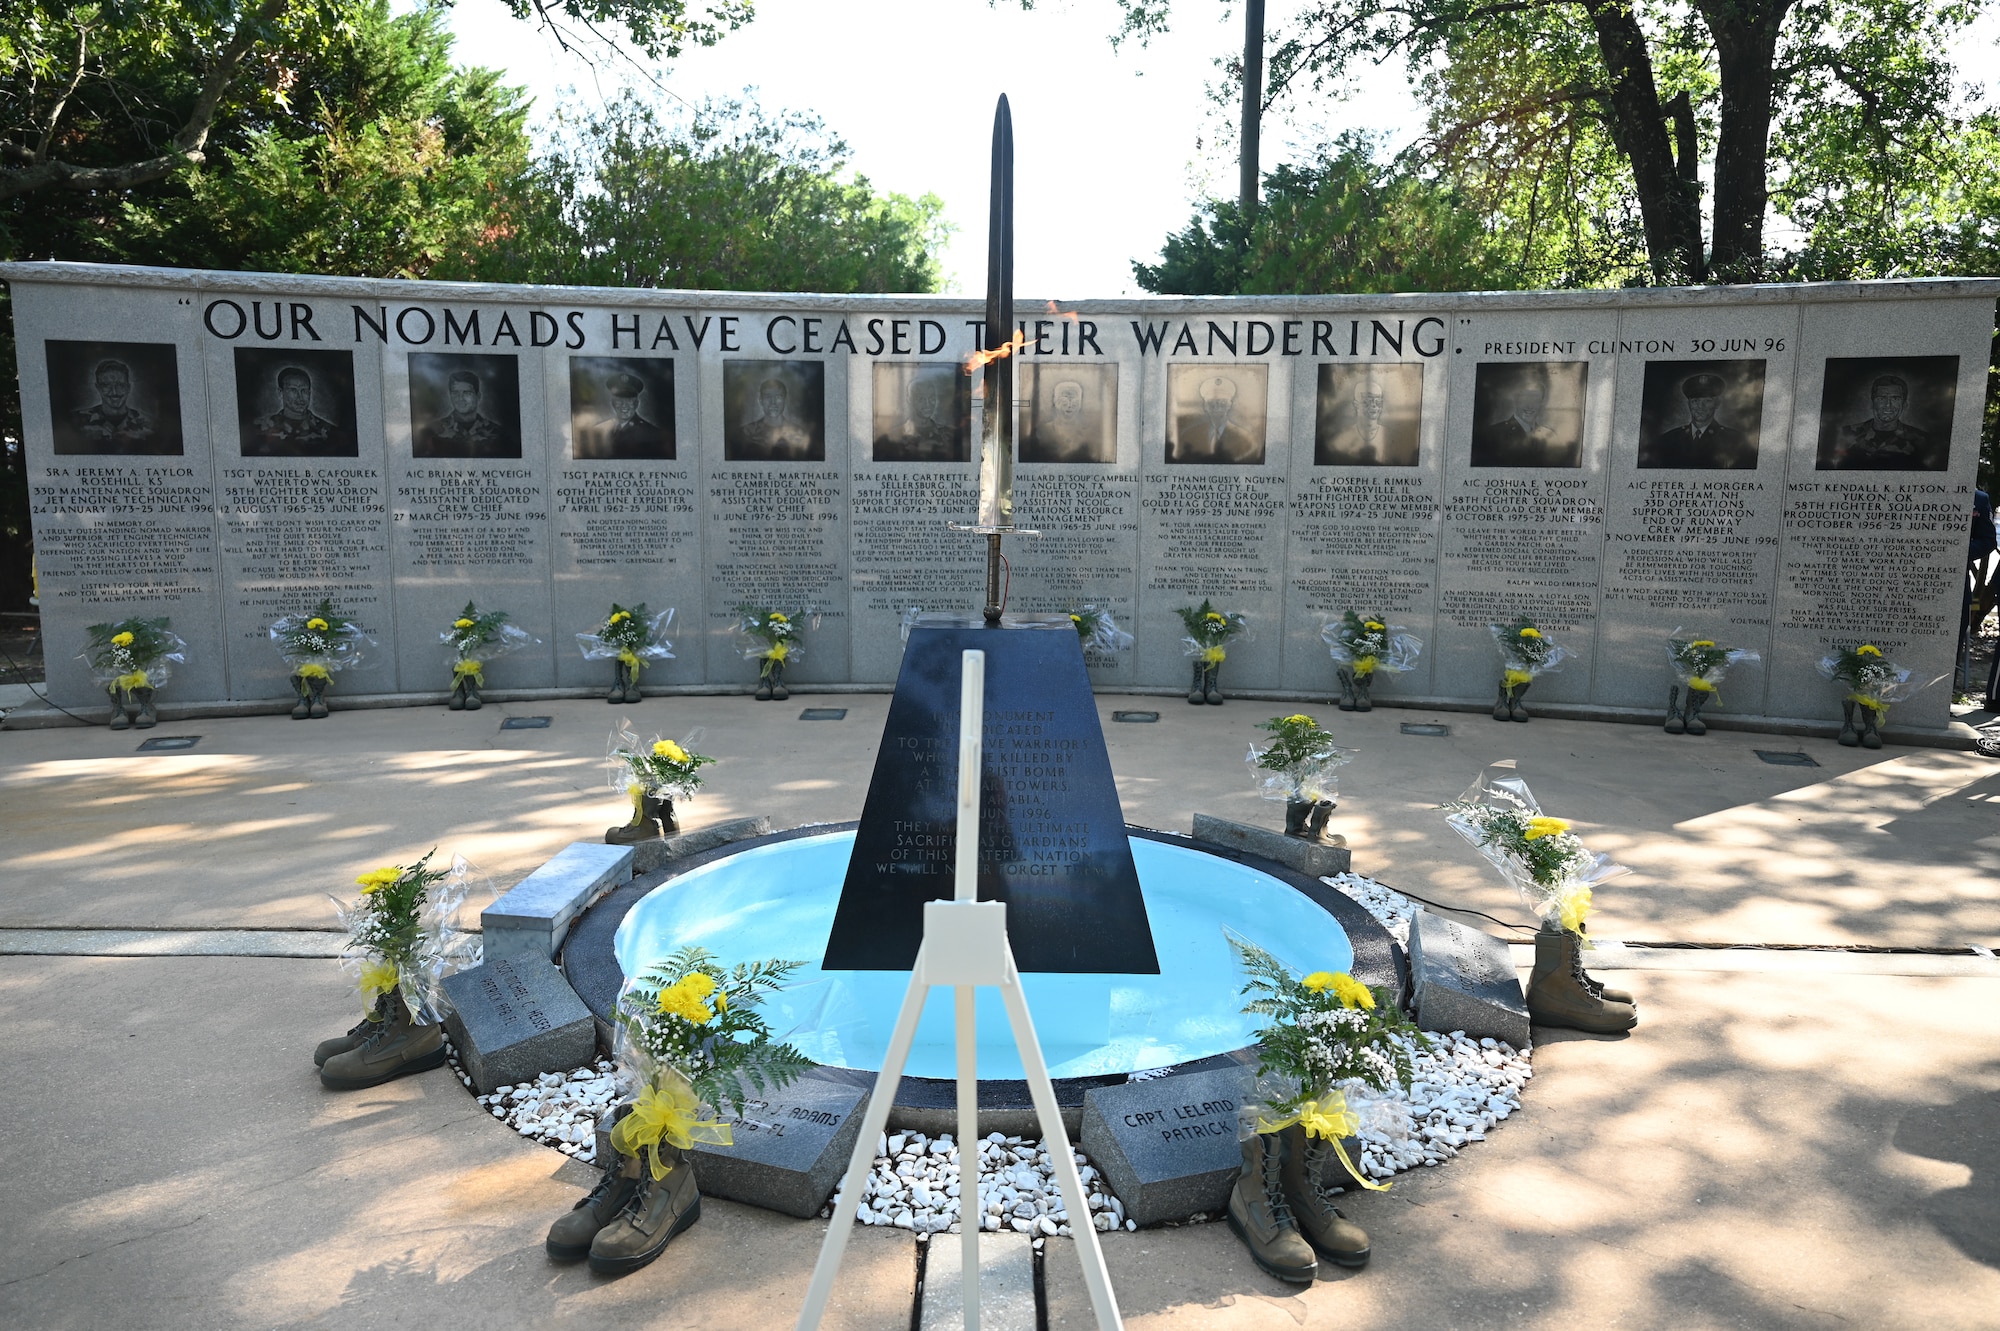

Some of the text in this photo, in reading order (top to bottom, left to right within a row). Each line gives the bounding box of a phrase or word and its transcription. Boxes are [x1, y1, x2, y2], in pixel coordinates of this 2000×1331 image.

[352, 304, 586, 350] NOMADS
[611, 314, 741, 352] HAVE
[766, 316, 947, 356] CEASED
[1484, 338, 1786, 355] PRESIDENT CLINTON 30 JUN 96
[46, 467, 194, 477] SRA JEREMY A. TAYLOR
[223, 469, 378, 478] TSGT DANIEL B. CAFOUREK
[428, 470, 463, 478] BRIAN
[467, 470, 478, 478] W.
[482, 470, 532, 478] MCVEIGH
[562, 471, 587, 480] TSGT
[592, 471, 634, 479] PATRICK
[649, 471, 688, 479] FENNIG
[731, 472, 763, 480] BRENT
[767, 472, 776, 480] E.
[779, 472, 839, 480] MARTHALER
[149, 477, 163, 486] KS
[853, 473, 872, 481] SRA
[875, 473, 899, 481] EARL
[1094, 475, 1139, 483] CAMPBELL
[1145, 475, 1169, 483] TSGT
[1172, 475, 1207, 483] THANH
[1208, 475, 1232, 484] (GUS)
[1244, 476, 1285, 484] NGUYEN
[1330, 477, 1369, 485] JOSEPH
[1372, 477, 1381, 485] E.
[1384, 478, 1422, 486] RIMKUS
[337, 479, 351, 487] SD
[487, 479, 498, 487] FL
[585, 480, 612, 488] PALM
[799, 480, 816, 488] MN
[1092, 482, 1104, 490] TX
[1484, 479, 1527, 488] JOSHUA
[1531, 480, 1539, 488] E.
[1544, 480, 1588, 489] WOODY
[1651, 482, 1685, 490] PETER
[1690, 482, 1699, 490] J.
[1703, 482, 1764, 491] MORGERA
[398, 488, 425, 496] 58TH
[479, 487, 540, 495] SQUADRON
[1246, 484, 1256, 492] FL
[1788, 483, 1820, 492] MSGT
[1824, 483, 1878, 493] KENDALL
[1884, 484, 1894, 493] K.
[1952, 485, 1973, 494] JR.
[1180, 492, 1231, 500] LOGISTICS
[1234, 492, 1270, 500] GROUP
[1546, 489, 1562, 497] CA
[1721, 491, 1739, 499] NH
[565, 497, 602, 505] FLIGHT
[633, 496, 686, 504] EXPEDITER
[721, 497, 773, 505] ASSISTANT
[1894, 494, 1913, 502] OK
[33, 505, 214, 514] 24 JANUARY 1973-25 JUNE 1996
[1031, 515, 1102, 523] MANAGEMENT
[1648, 526, 1734, 535] CREW MEMBER
[983, 711, 1055, 722] ONUMENT
[982, 724, 1043, 735] DICATED
[898, 737, 919, 749] TO
[1012, 739, 1089, 750] WARRIORS
[1000, 753, 1050, 763] KILLED
[1056, 753, 1074, 763] BY
[1024, 767, 1065, 778] BOMB
[1019, 822, 1090, 834] ULTIMATE
[897, 835, 956, 847] SACRIFI
[890, 849, 909, 860] OF
[917, 849, 948, 861] THIS
[876, 864, 897, 875] WE
[902, 864, 938, 875] WILL
[788, 1107, 841, 1126] ADAMS
[1124, 1099, 1234, 1128] CAPT LELAND
[767, 1123, 785, 1137] FL
[1161, 1120, 1233, 1143] PATRICK
